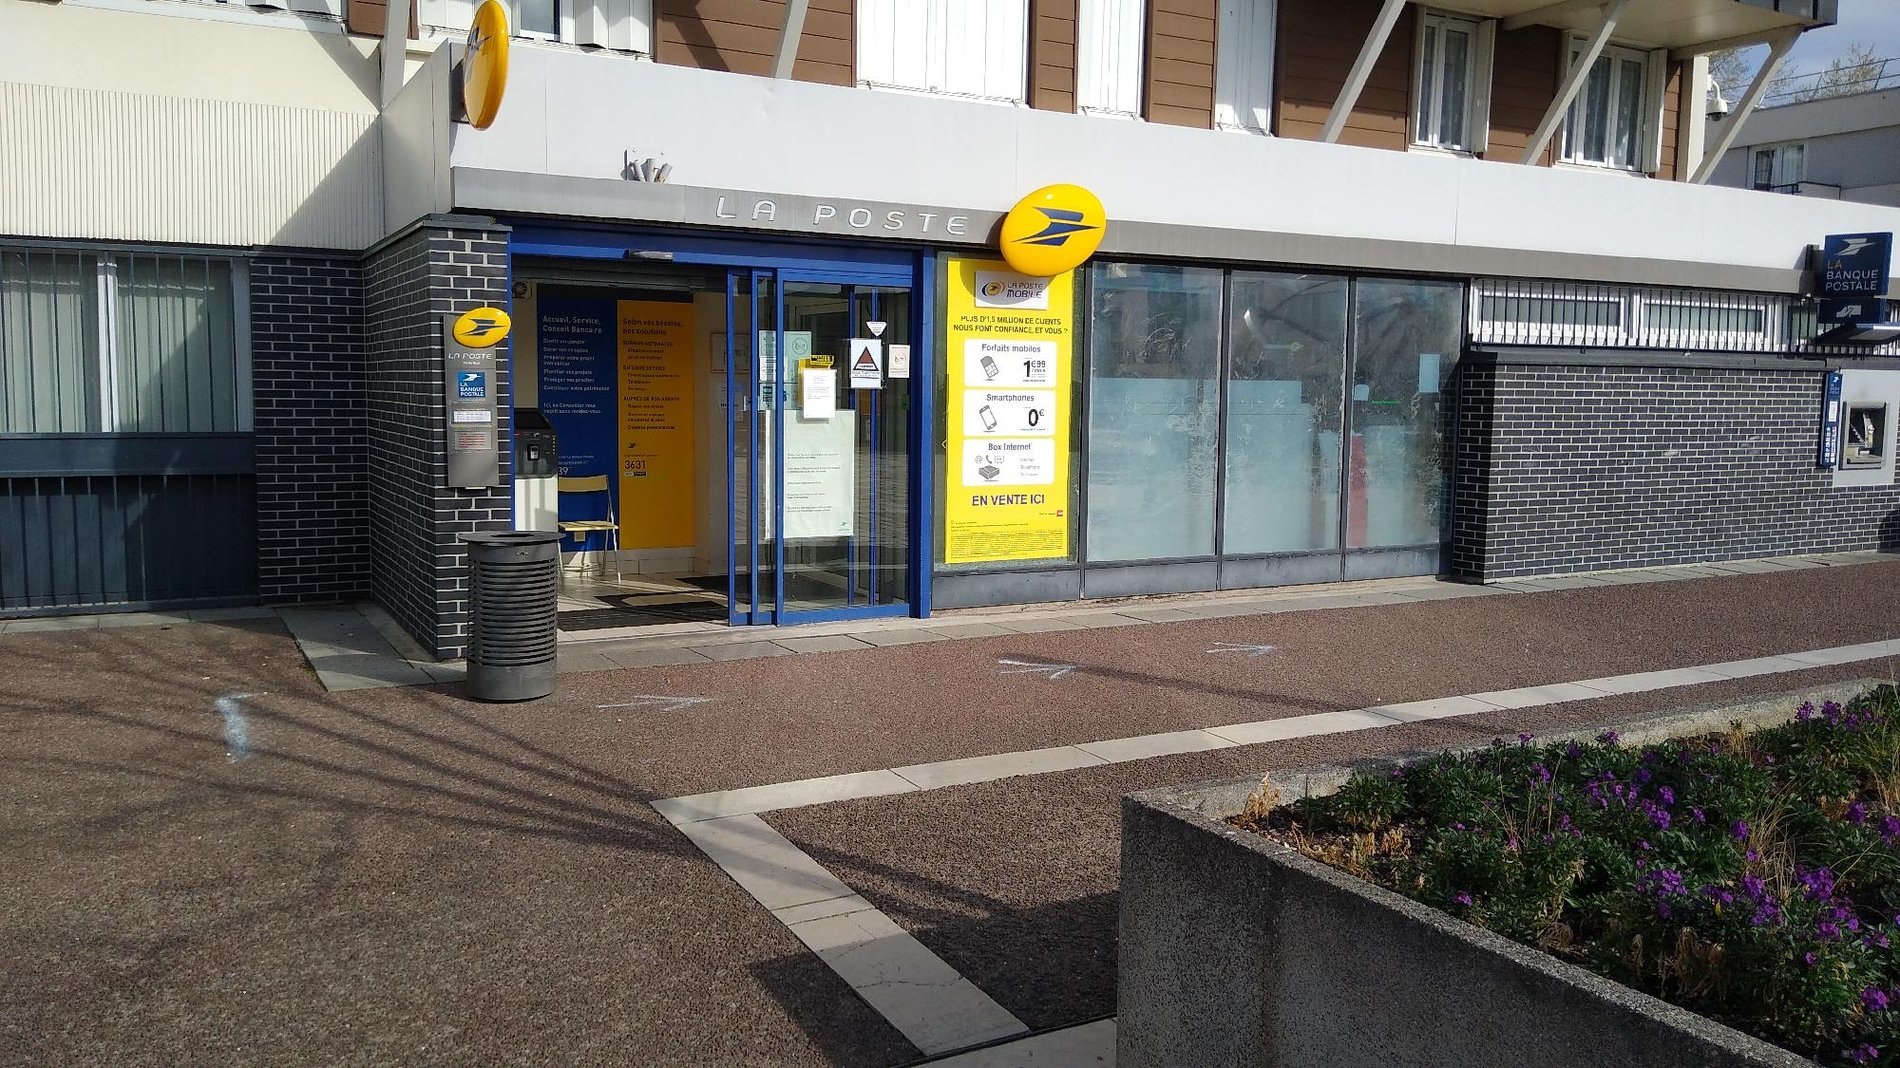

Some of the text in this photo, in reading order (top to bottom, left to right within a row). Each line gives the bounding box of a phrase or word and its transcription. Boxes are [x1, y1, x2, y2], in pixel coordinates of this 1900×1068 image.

[716, 196, 968, 235] LA POSTE
[1828, 260, 1842, 269] LA
[1826, 269, 1878, 280] BANQUE
[1826, 280, 1878, 291] POSTALE
[1007, 290, 1042, 298] MOBILE
[982, 344, 1040, 352] Forfaits mobiles
[987, 394, 1034, 402] Smartphones
[624, 460, 646, 469] 3631
[558, 467, 568, 475] 39
[972, 494, 1045, 506] EN VENTE ICI
